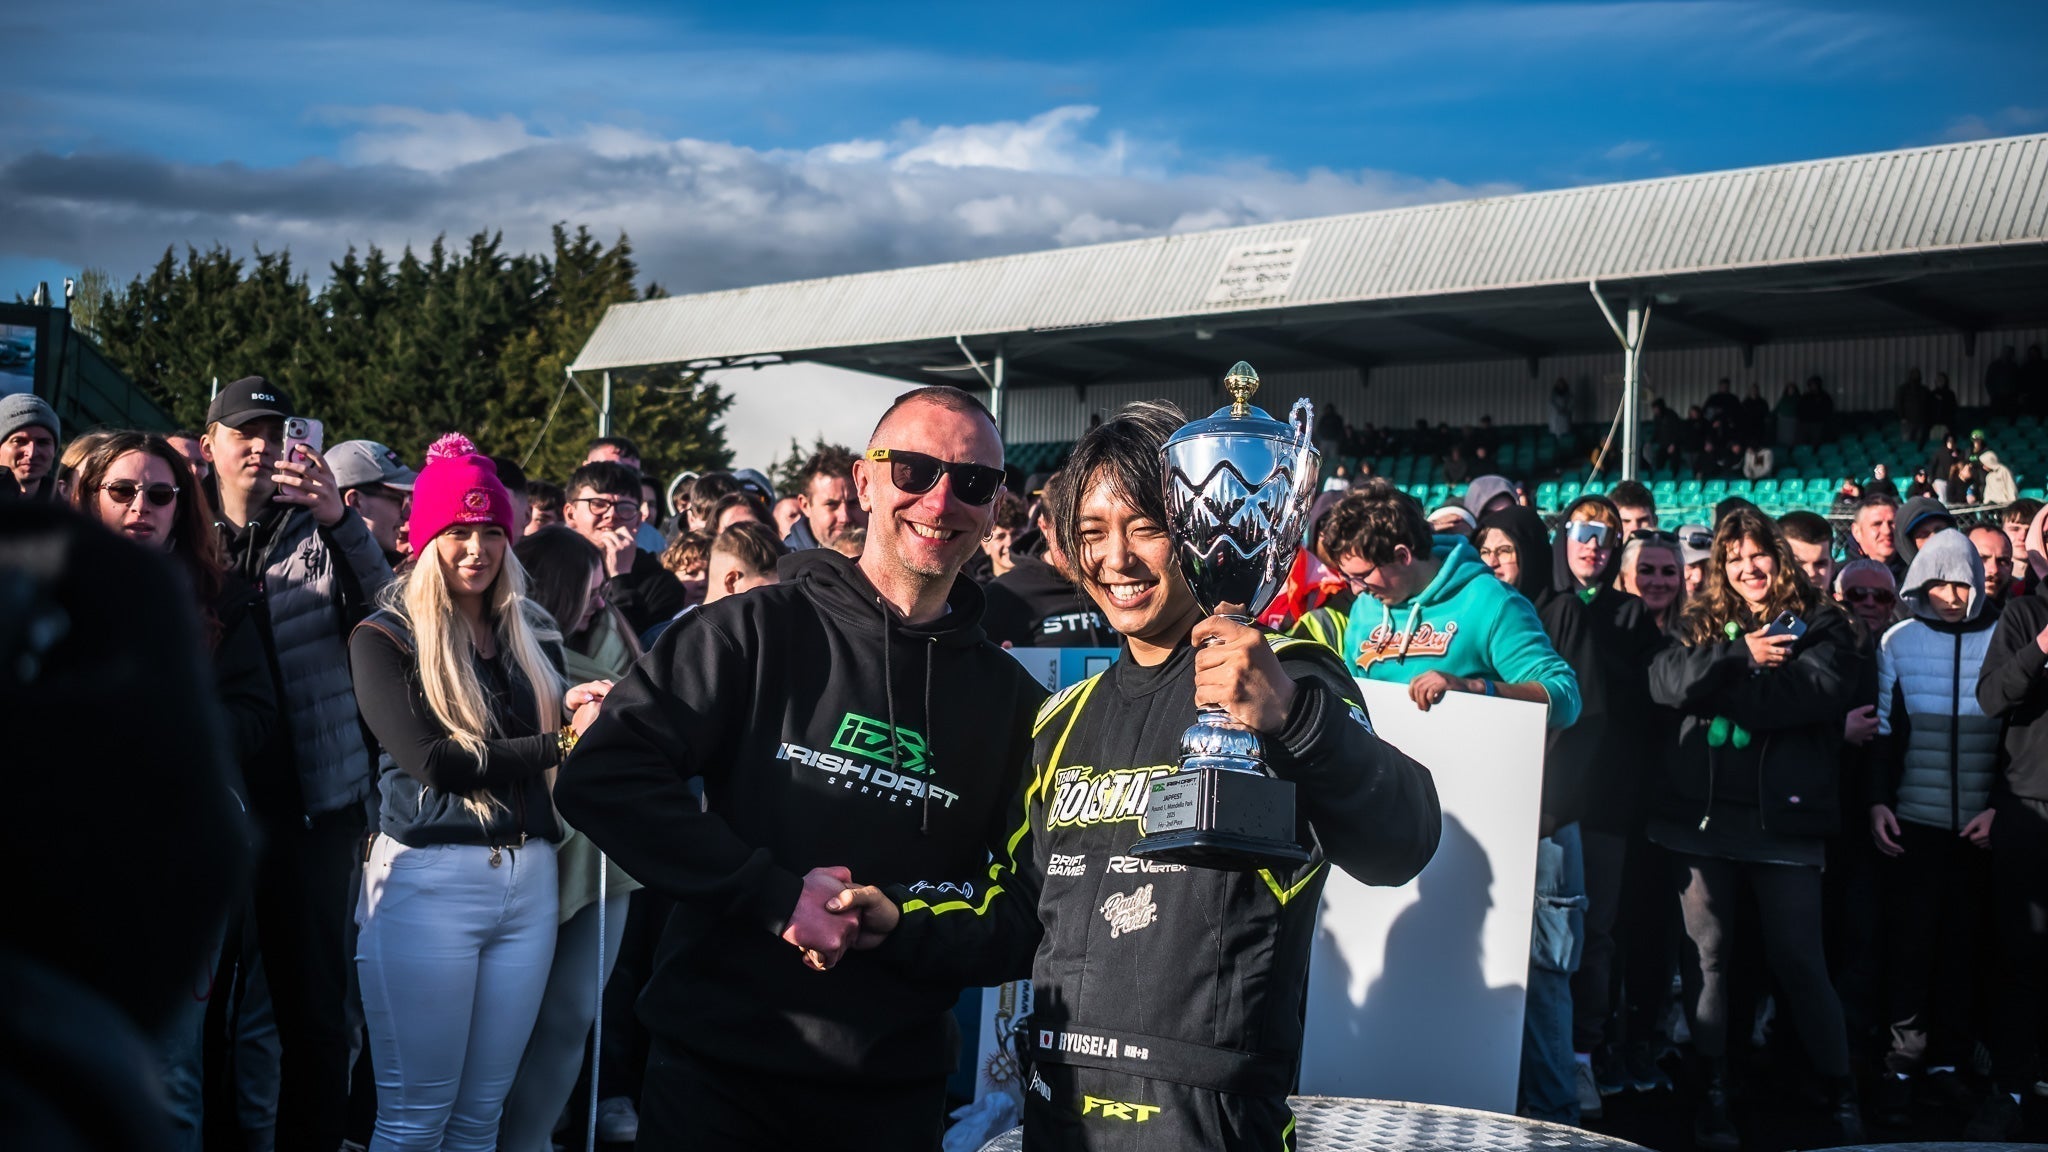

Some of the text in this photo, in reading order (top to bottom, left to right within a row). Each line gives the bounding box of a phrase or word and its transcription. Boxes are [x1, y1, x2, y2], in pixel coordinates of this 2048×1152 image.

[251, 392, 275, 402] BOSS
[775, 742, 959, 808] IRISH DRIFT
[1057, 769, 1082, 786] TEAM
[827, 776, 913, 807] SERIES
[1049, 854, 1086, 866] DRIFT
[1047, 864, 1087, 877] GAMES
[1082, 1095, 1161, 1123] FRT
